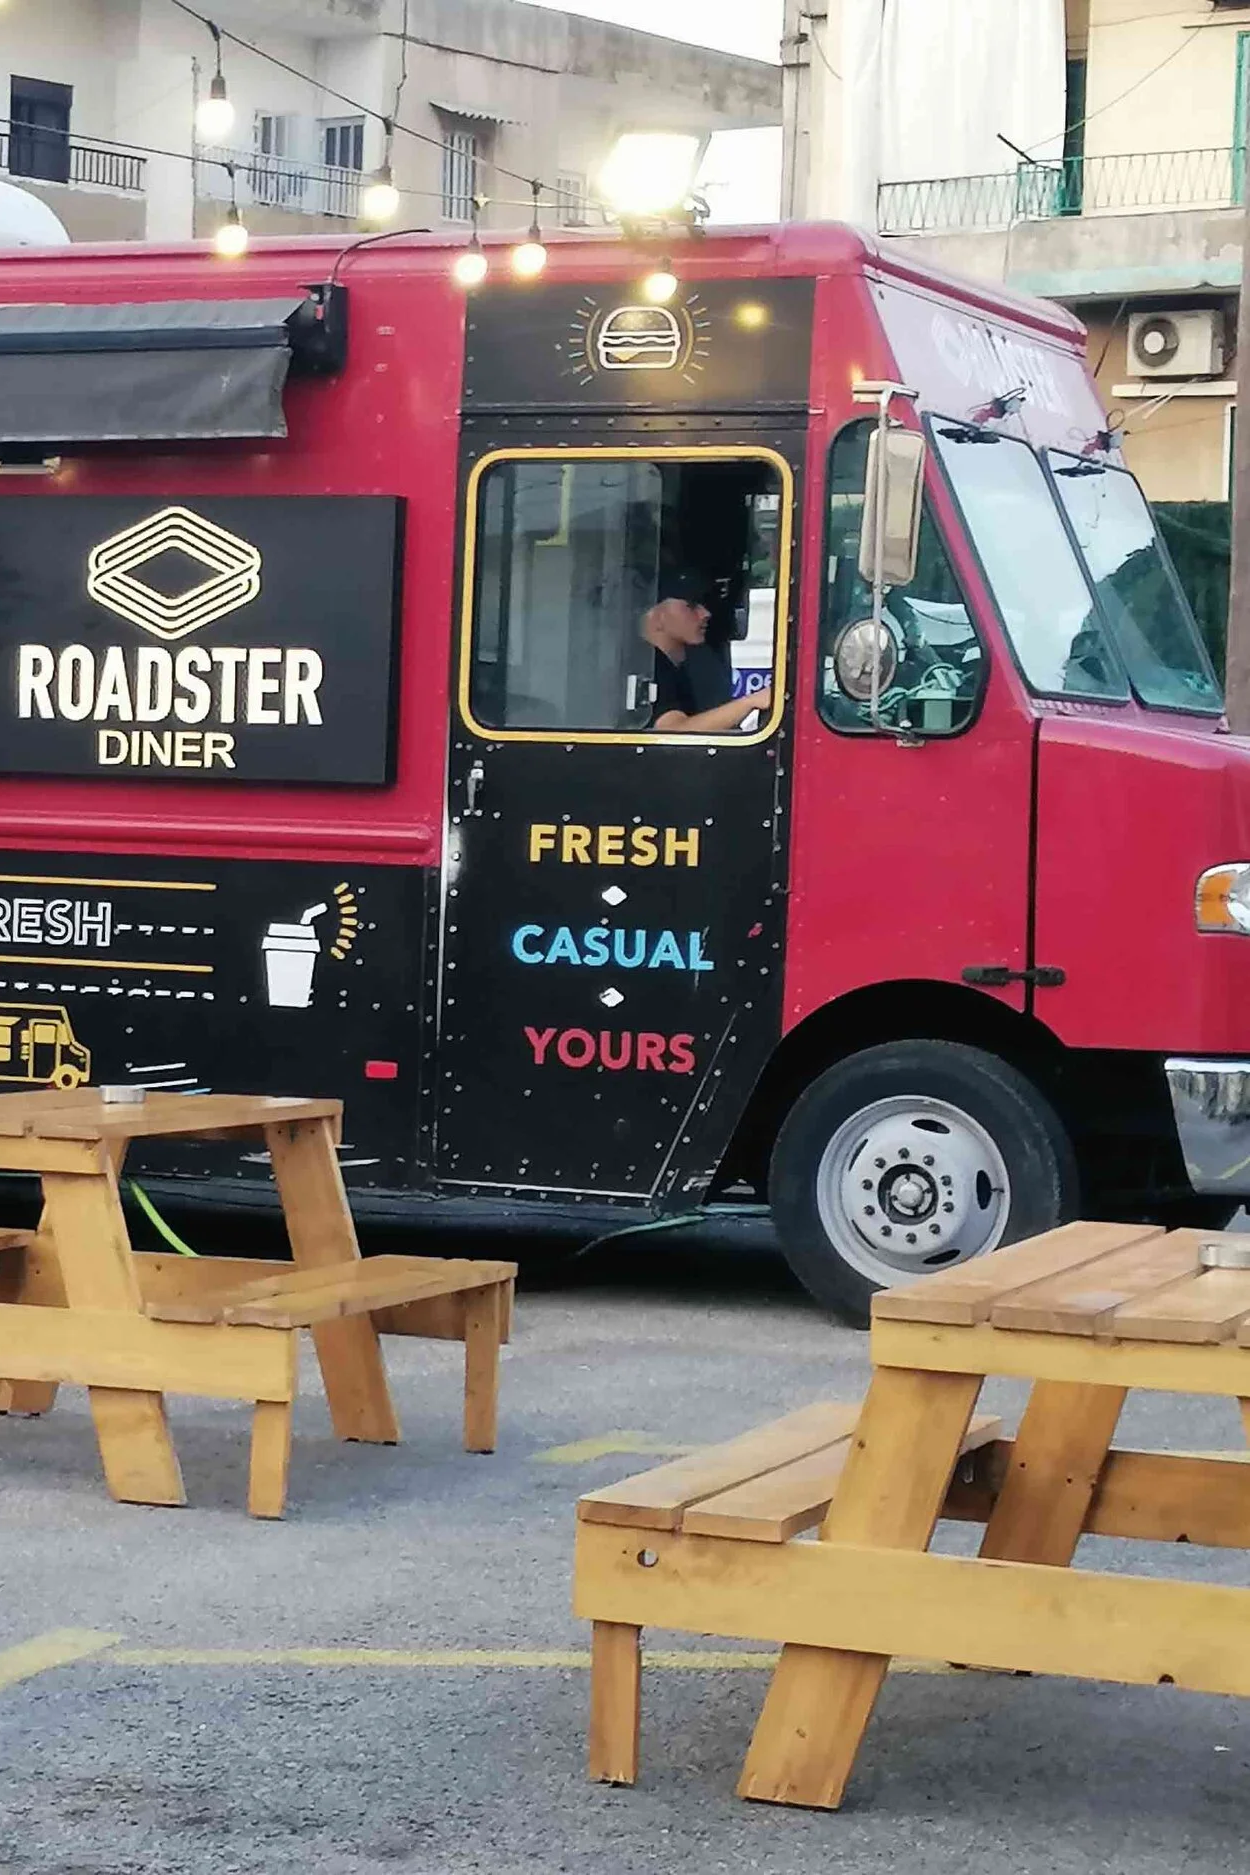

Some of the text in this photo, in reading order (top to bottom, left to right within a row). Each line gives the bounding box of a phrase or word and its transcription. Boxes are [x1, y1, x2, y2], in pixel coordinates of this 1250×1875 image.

[17, 643, 324, 726] ROADSTER
[98, 729, 237, 769] DINER
[529, 823, 700, 867] FRESH
[511, 924, 715, 971] CASUAL
[523, 1026, 696, 1074] YOURS
